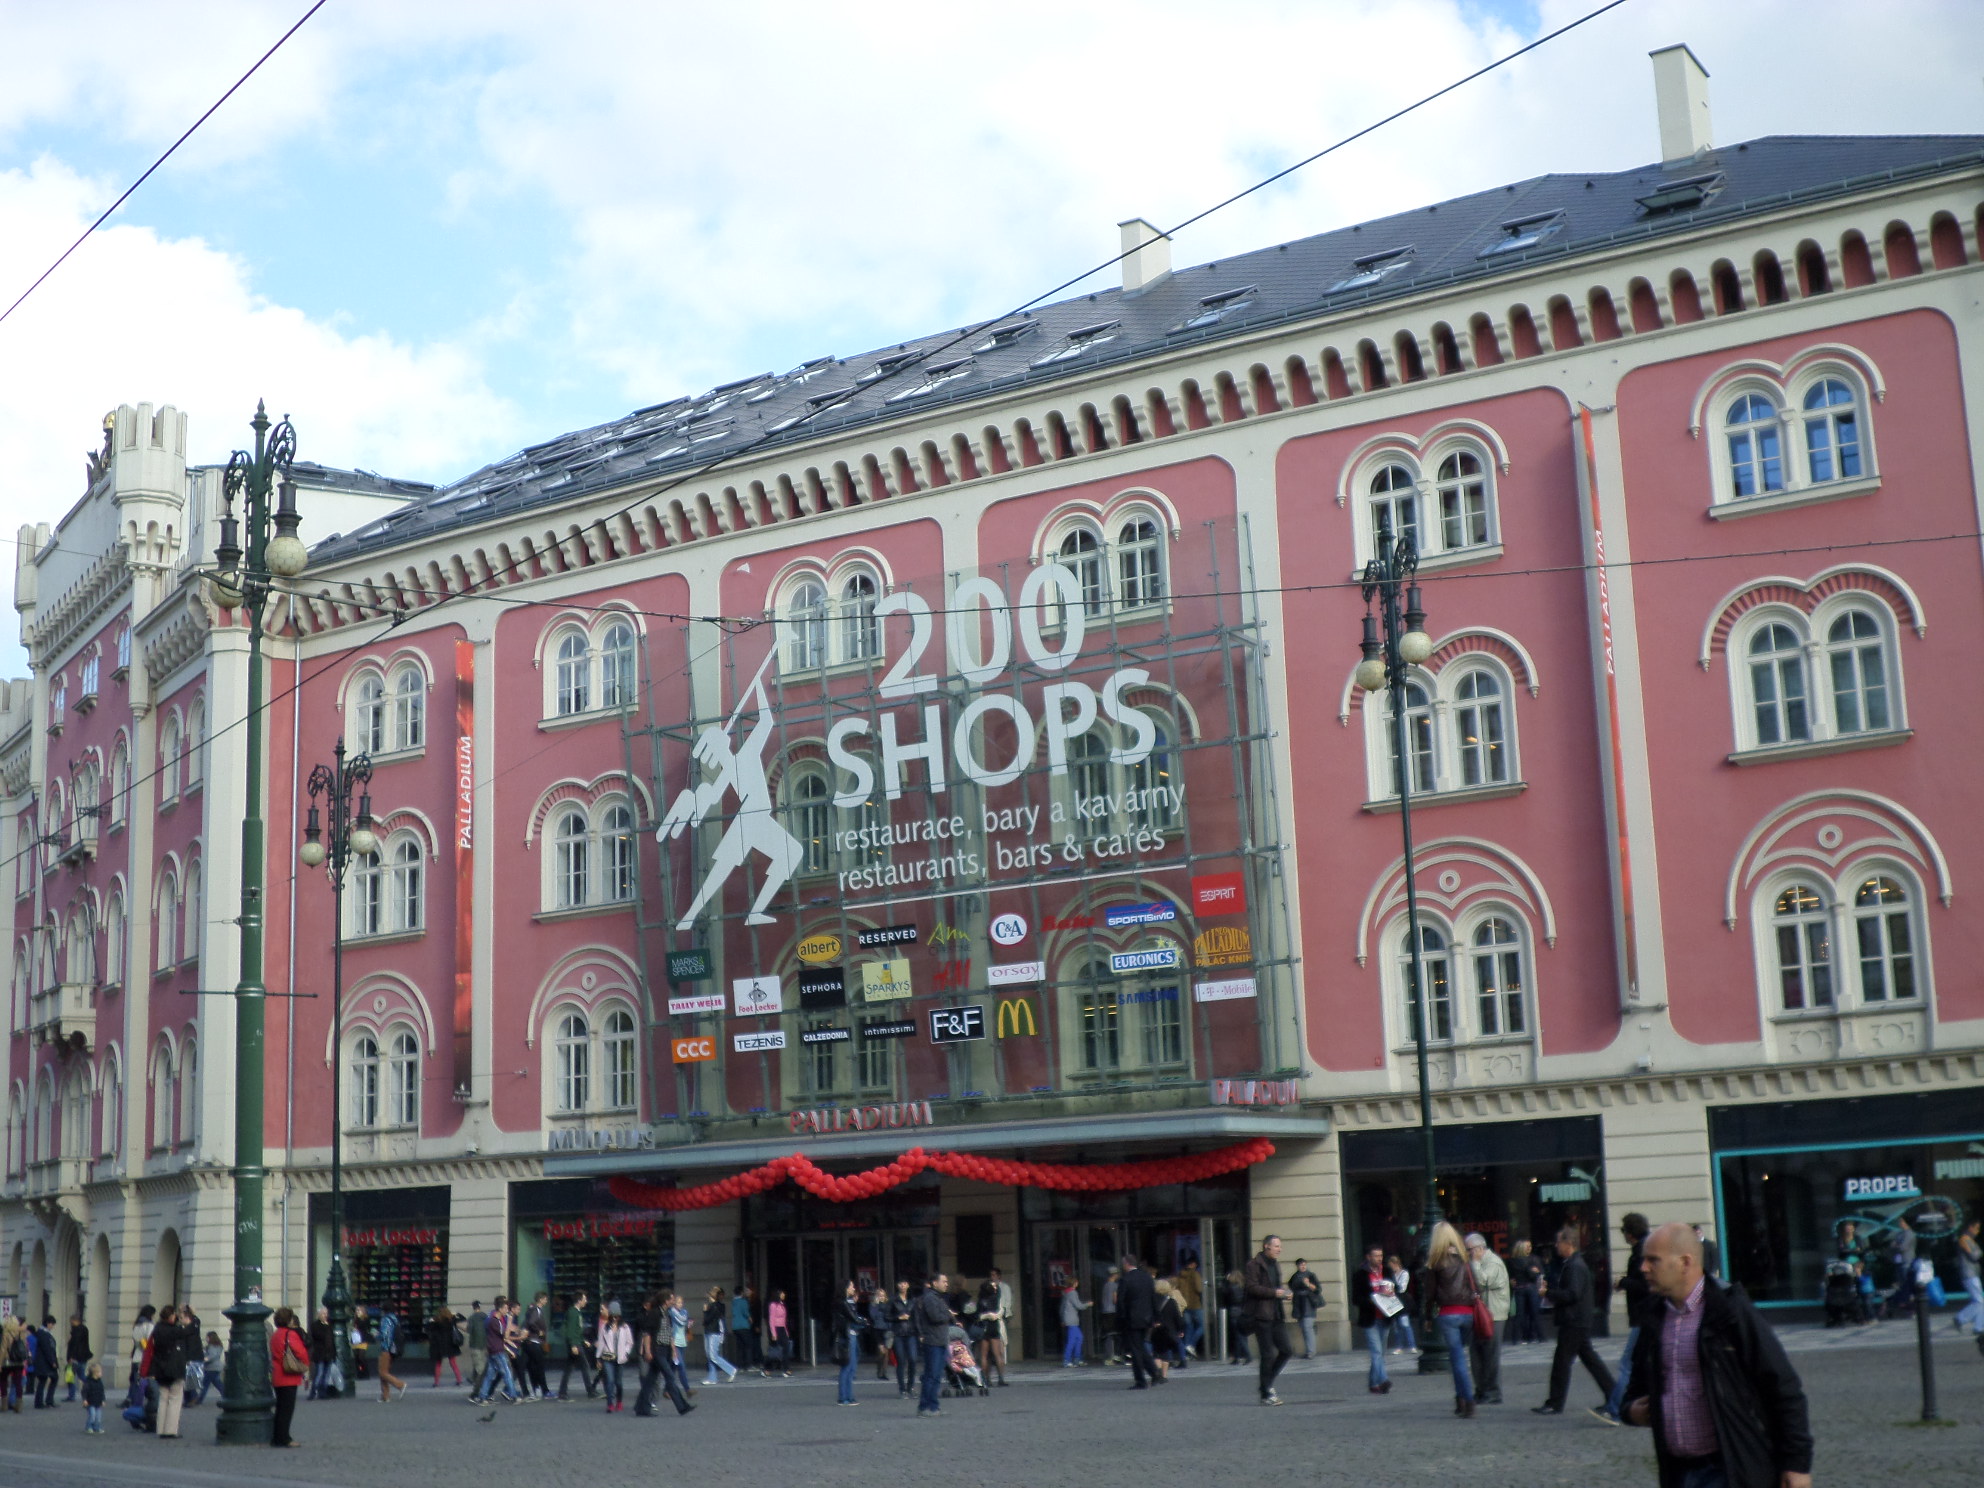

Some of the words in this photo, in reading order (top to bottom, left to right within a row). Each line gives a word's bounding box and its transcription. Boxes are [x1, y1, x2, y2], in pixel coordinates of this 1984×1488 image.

[872, 563, 1085, 699] 200
[827, 668, 1156, 808] SHOPS
[460, 736, 472, 848] PALLADIUM
[835, 816, 973, 851] restaurace,
[982, 803, 1040, 835] bary
[1050, 801, 1066, 823] a
[1074, 783, 1186, 820] kavárny
[839, 849, 986, 891] restaurants,
[996, 840, 1052, 870] bars
[1063, 833, 1085, 861] &
[1093, 823, 1166, 858] cafés
[1200, 887, 1236, 902] ESPRIT
[859, 929, 917, 945] RESERVED
[995, 920, 1024, 938] C&A
[800, 940, 837, 956] albert
[1194, 927, 1250, 954] PALLADIUM
[1114, 952, 1174, 968] EURONICS
[672, 965, 705, 976] SPENCER
[991, 964, 1040, 980] orsay
[801, 981, 843, 994] SEPHORA
[865, 981, 910, 995] SPARKYS
[1118, 988, 1180, 1005] SAMSUNG
[738, 1005, 753, 1013] Foot
[864, 1025, 915, 1036] intimissimi
[932, 1010, 980, 1039] F&F
[803, 1031, 849, 1042] CALZEDONIA
[676, 1041, 711, 1059] CCC
[1216, 1079, 1301, 1106] PALLADIUM
[789, 1101, 933, 1133] PALLADIUM
[1846, 1176, 1919, 1195] PROPEL
[381, 1224, 439, 1247] Locker
[543, 1218, 585, 1240] Foot
